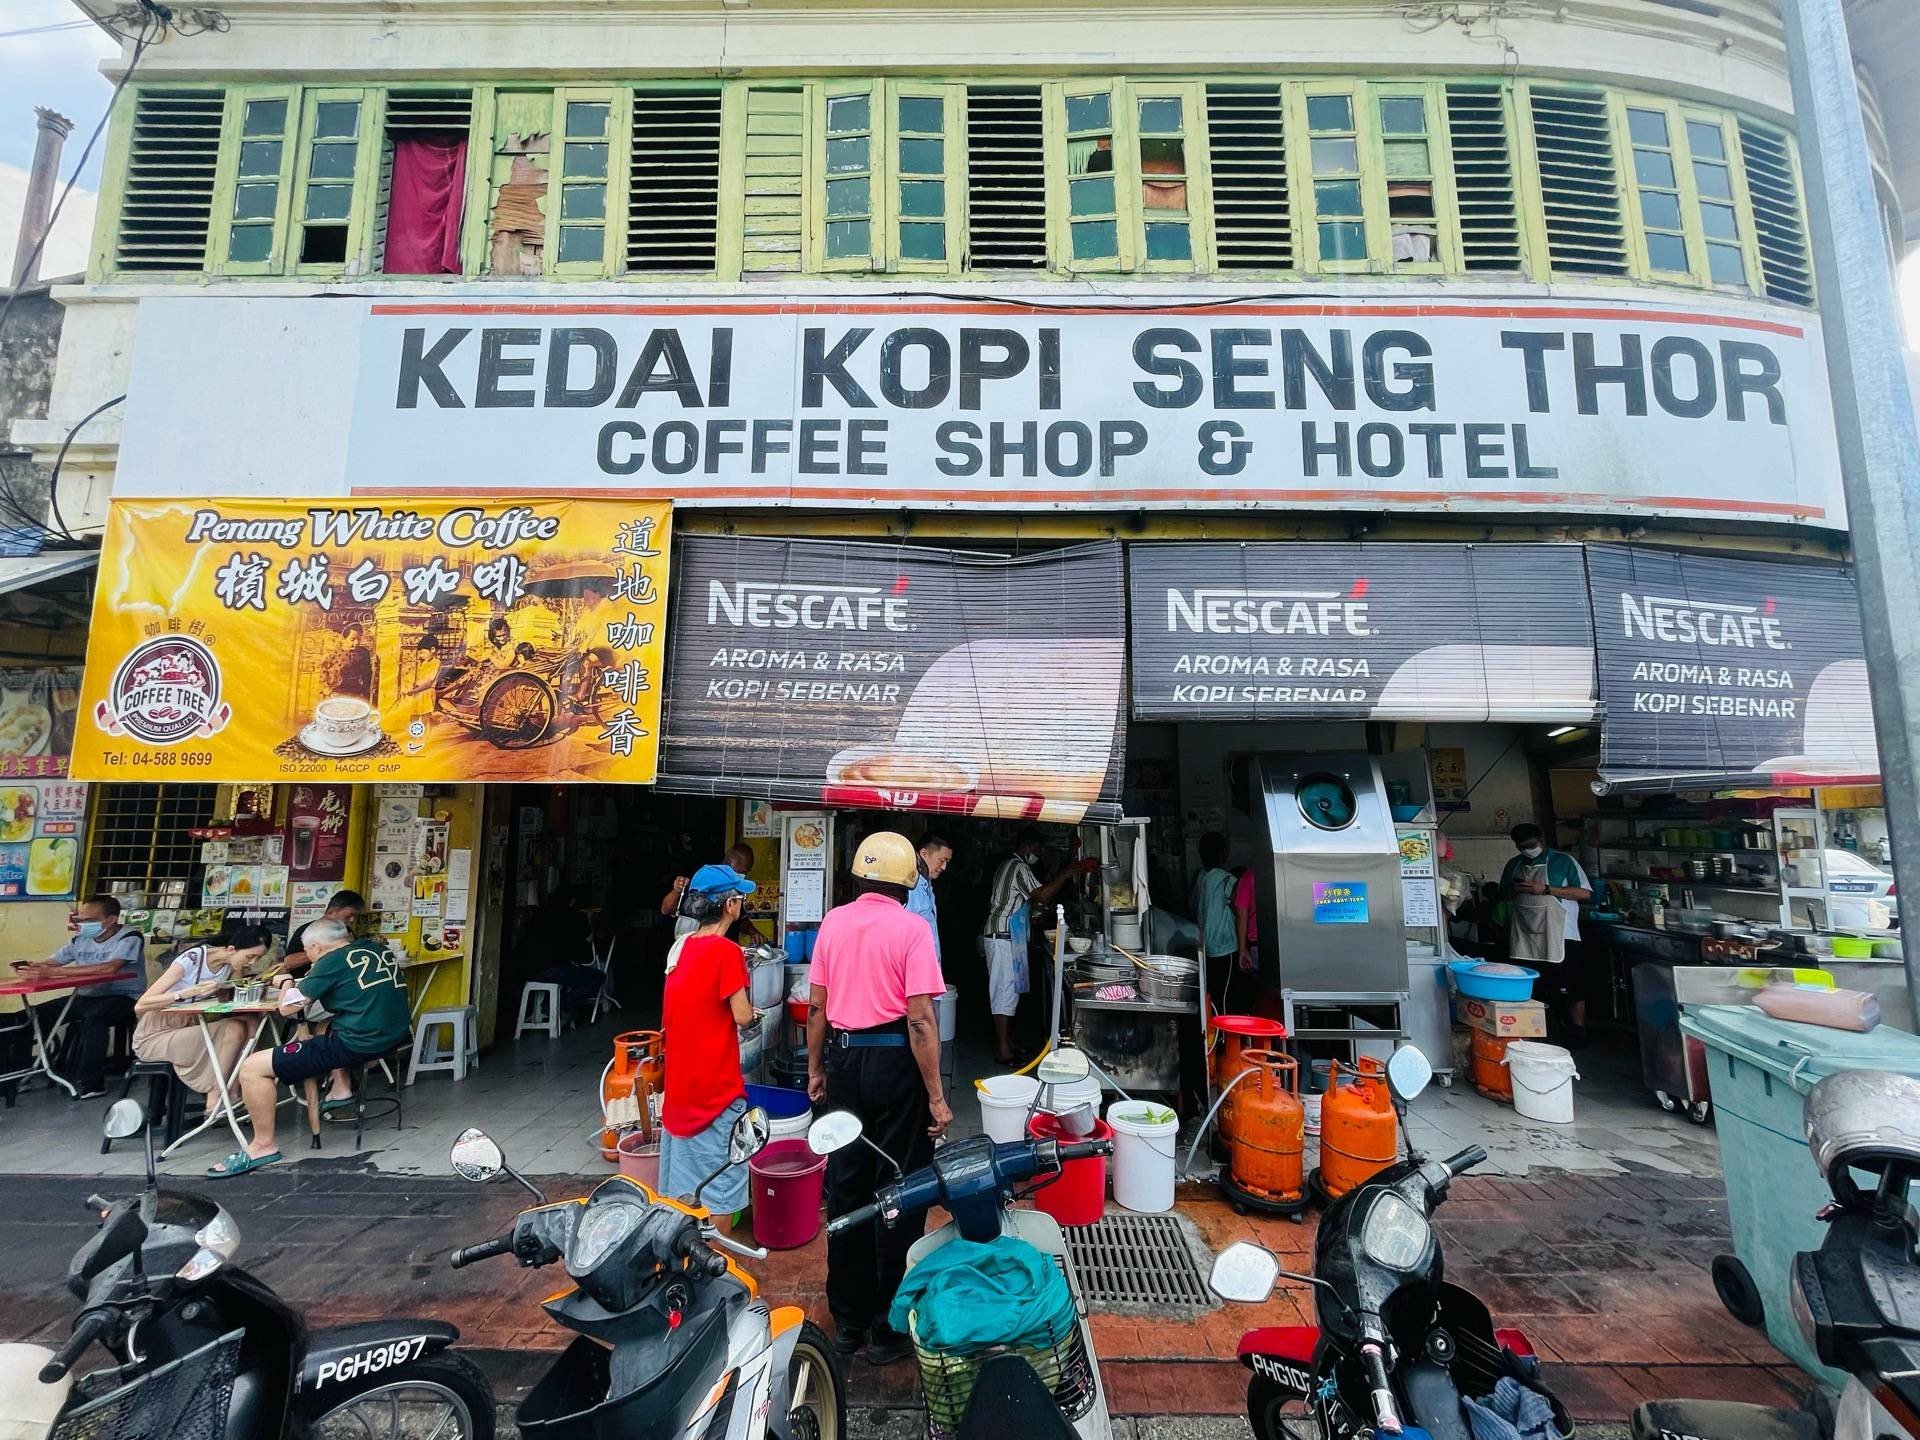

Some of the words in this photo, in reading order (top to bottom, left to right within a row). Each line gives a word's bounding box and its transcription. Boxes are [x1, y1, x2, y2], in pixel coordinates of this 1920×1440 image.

[396, 327, 734, 409] KEDAI
[801, 327, 1061, 410] KOPI
[1132, 327, 1437, 412] SENG
[1501, 331, 1787, 426] THOR
[596, 419, 888, 475] COFFEE
[935, 420, 1148, 477] SHOP
[1197, 420, 1253, 476] &
[1301, 422, 1559, 479] HOTEL
[185, 509, 305, 548] Penang
[307, 507, 434, 547] White
[437, 507, 560, 549] Coffee
[215, 552, 528, 611] 檳城白咖啡
[598, 516, 662, 757] 道地咖啡香
[709, 648, 806, 669] AROMA
[813, 652, 830, 670] &
[836, 652, 905, 672] RASA
[1173, 654, 1270, 675] AROMA
[1276, 656, 1293, 676] &
[1300, 657, 1370, 678] RASA
[1632, 661, 1713, 685] AROMA
[1718, 667, 1732, 686] &
[1737, 668, 1794, 689] RASA
[124, 687, 172, 711] COFFEE
[178, 688, 205, 714] TREE
[705, 678, 769, 700] KOPI
[775, 680, 901, 703] SEBENAR
[1172, 684, 1234, 702] KOPI
[1241, 686, 1367, 702] SEBENAR
[1633, 692, 1686, 713] KOPI
[1691, 696, 1796, 718] SEBENAR
[131, 712, 162, 732] PREMIUM
[162, 714, 195, 733] QUALITY
[103, 751, 128, 765] Tel:
[132, 752, 177, 766] 04-588
[181, 752, 212, 766] 9699
[279, 764, 297, 773] ISO
[298, 764, 327, 773] 22000
[334, 764, 370, 773] HACCP
[377, 764, 400, 773] GMP
[315, 1335, 427, 1390] PGH3197
